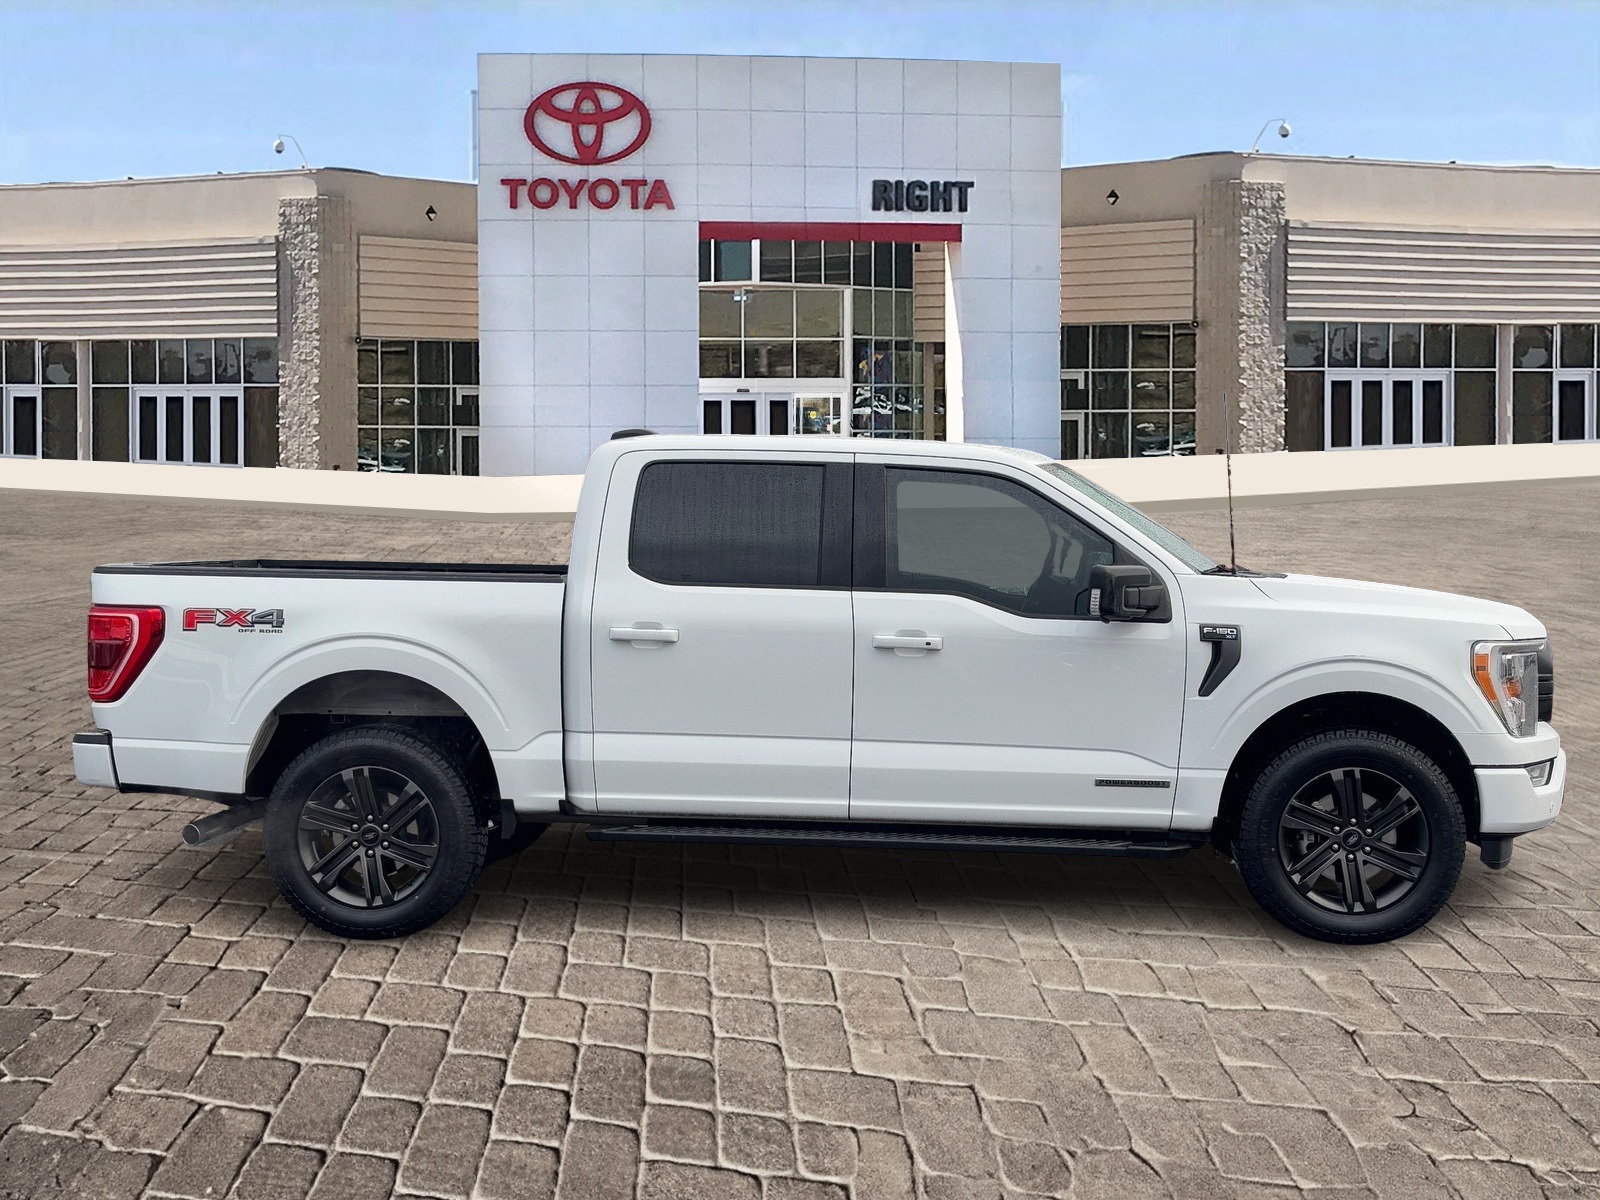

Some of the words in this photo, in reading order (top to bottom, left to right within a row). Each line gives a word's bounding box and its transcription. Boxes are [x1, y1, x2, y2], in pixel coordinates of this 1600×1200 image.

[500, 177, 675, 210] TOYOTA
[872, 179, 975, 212] RIGHT
[183, 607, 285, 631] FX4
